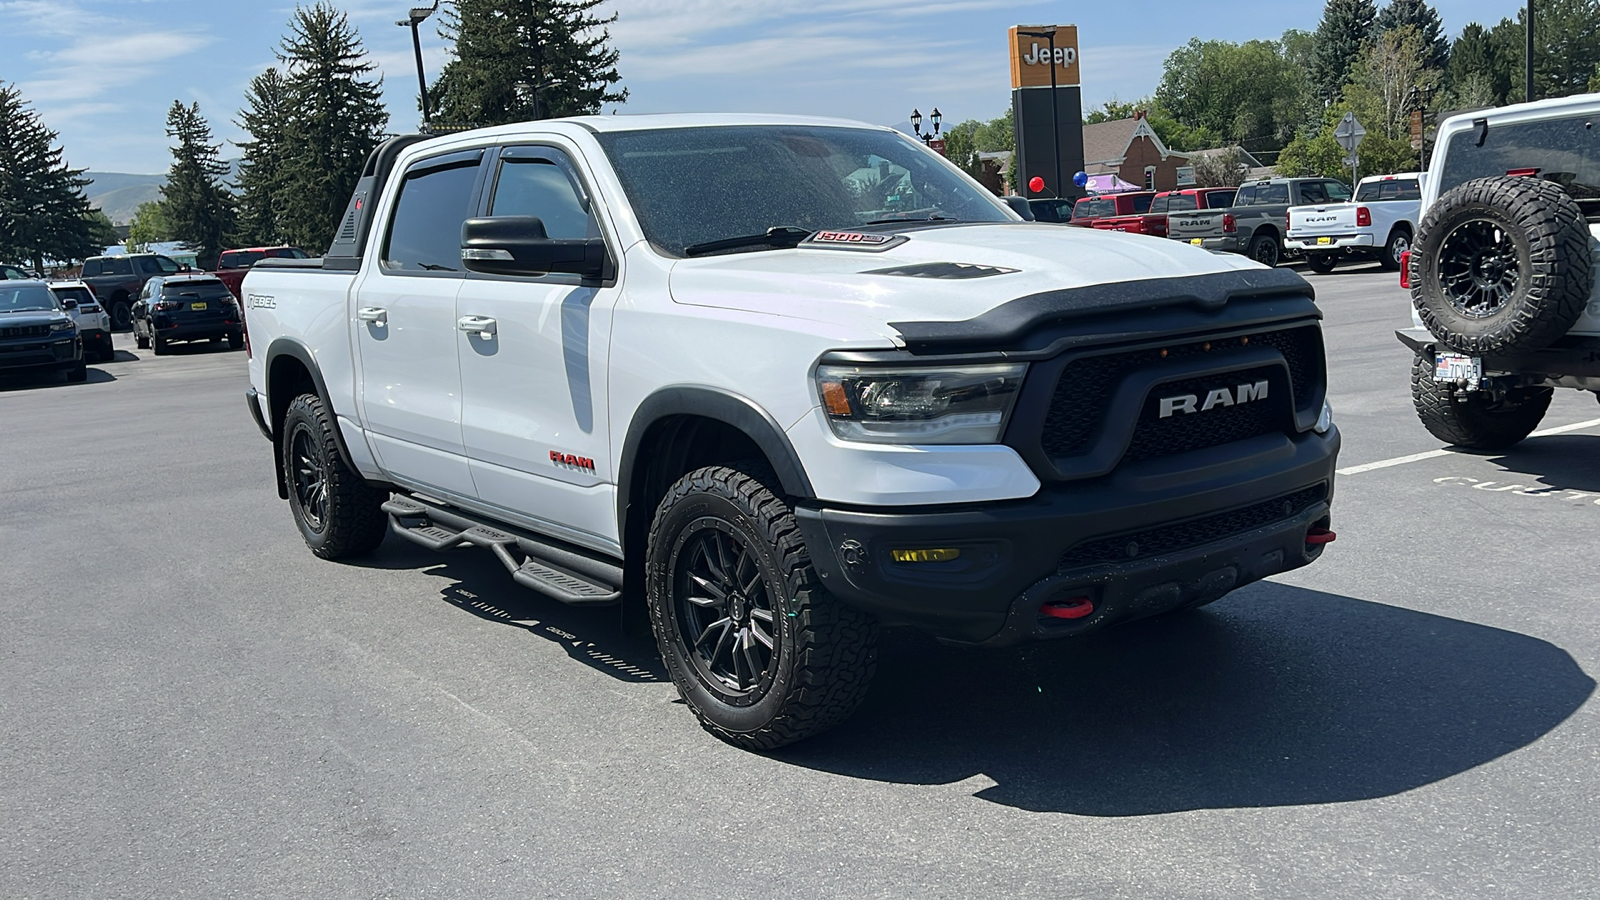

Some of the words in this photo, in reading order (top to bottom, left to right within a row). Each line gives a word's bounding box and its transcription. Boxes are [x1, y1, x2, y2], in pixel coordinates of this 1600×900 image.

[1023, 42, 1076, 69] Jeep
[1180, 219, 1211, 227] RAM
[817, 230, 863, 242] 1500
[247, 293, 277, 310] REBEL
[1159, 380, 1269, 418] RAM
[549, 449, 595, 470] RAM
[1432, 476, 1600, 505] CUST
